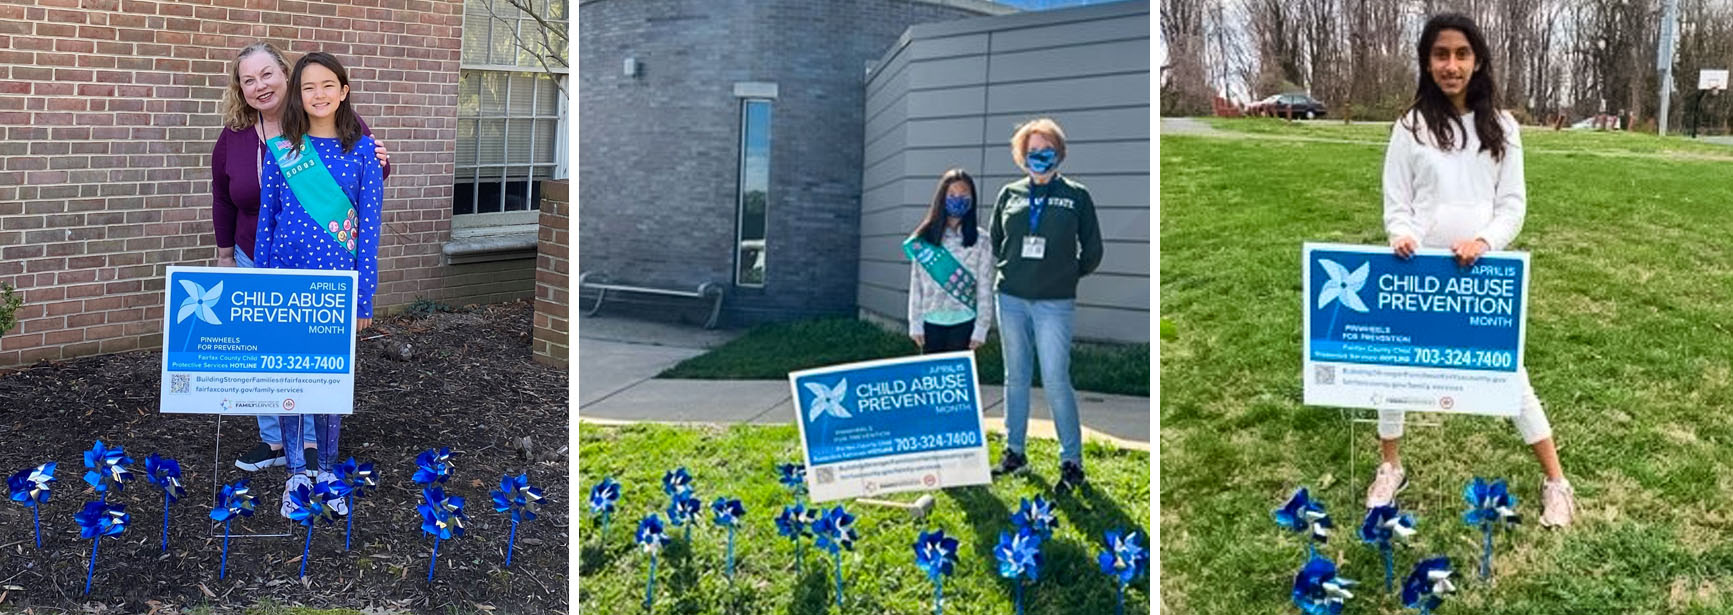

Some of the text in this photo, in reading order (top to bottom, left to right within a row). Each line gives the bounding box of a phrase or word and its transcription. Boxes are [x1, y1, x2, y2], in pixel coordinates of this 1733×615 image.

[1472, 265, 1516, 276] APRIL IS
[309, 282, 346, 291] APRIL IS
[1378, 274, 1514, 297] CHILD ABUSE
[231, 291, 346, 308] CHILD ABUSE
[1378, 292, 1512, 315] PREVENTION
[230, 307, 345, 324] PREVENTION
[1470, 316, 1512, 328] MONTH
[308, 326, 345, 334] MONTH
[200, 336, 240, 344] PINWHEELS
[260, 355, 344, 370] 703-324-7400
[1414, 348, 1512, 368] 703-324-7400
[856, 374, 968, 398] CHILD ABUSE
[858, 388, 970, 413] PREVENTION
[894, 431, 976, 452] 703-324-7400
